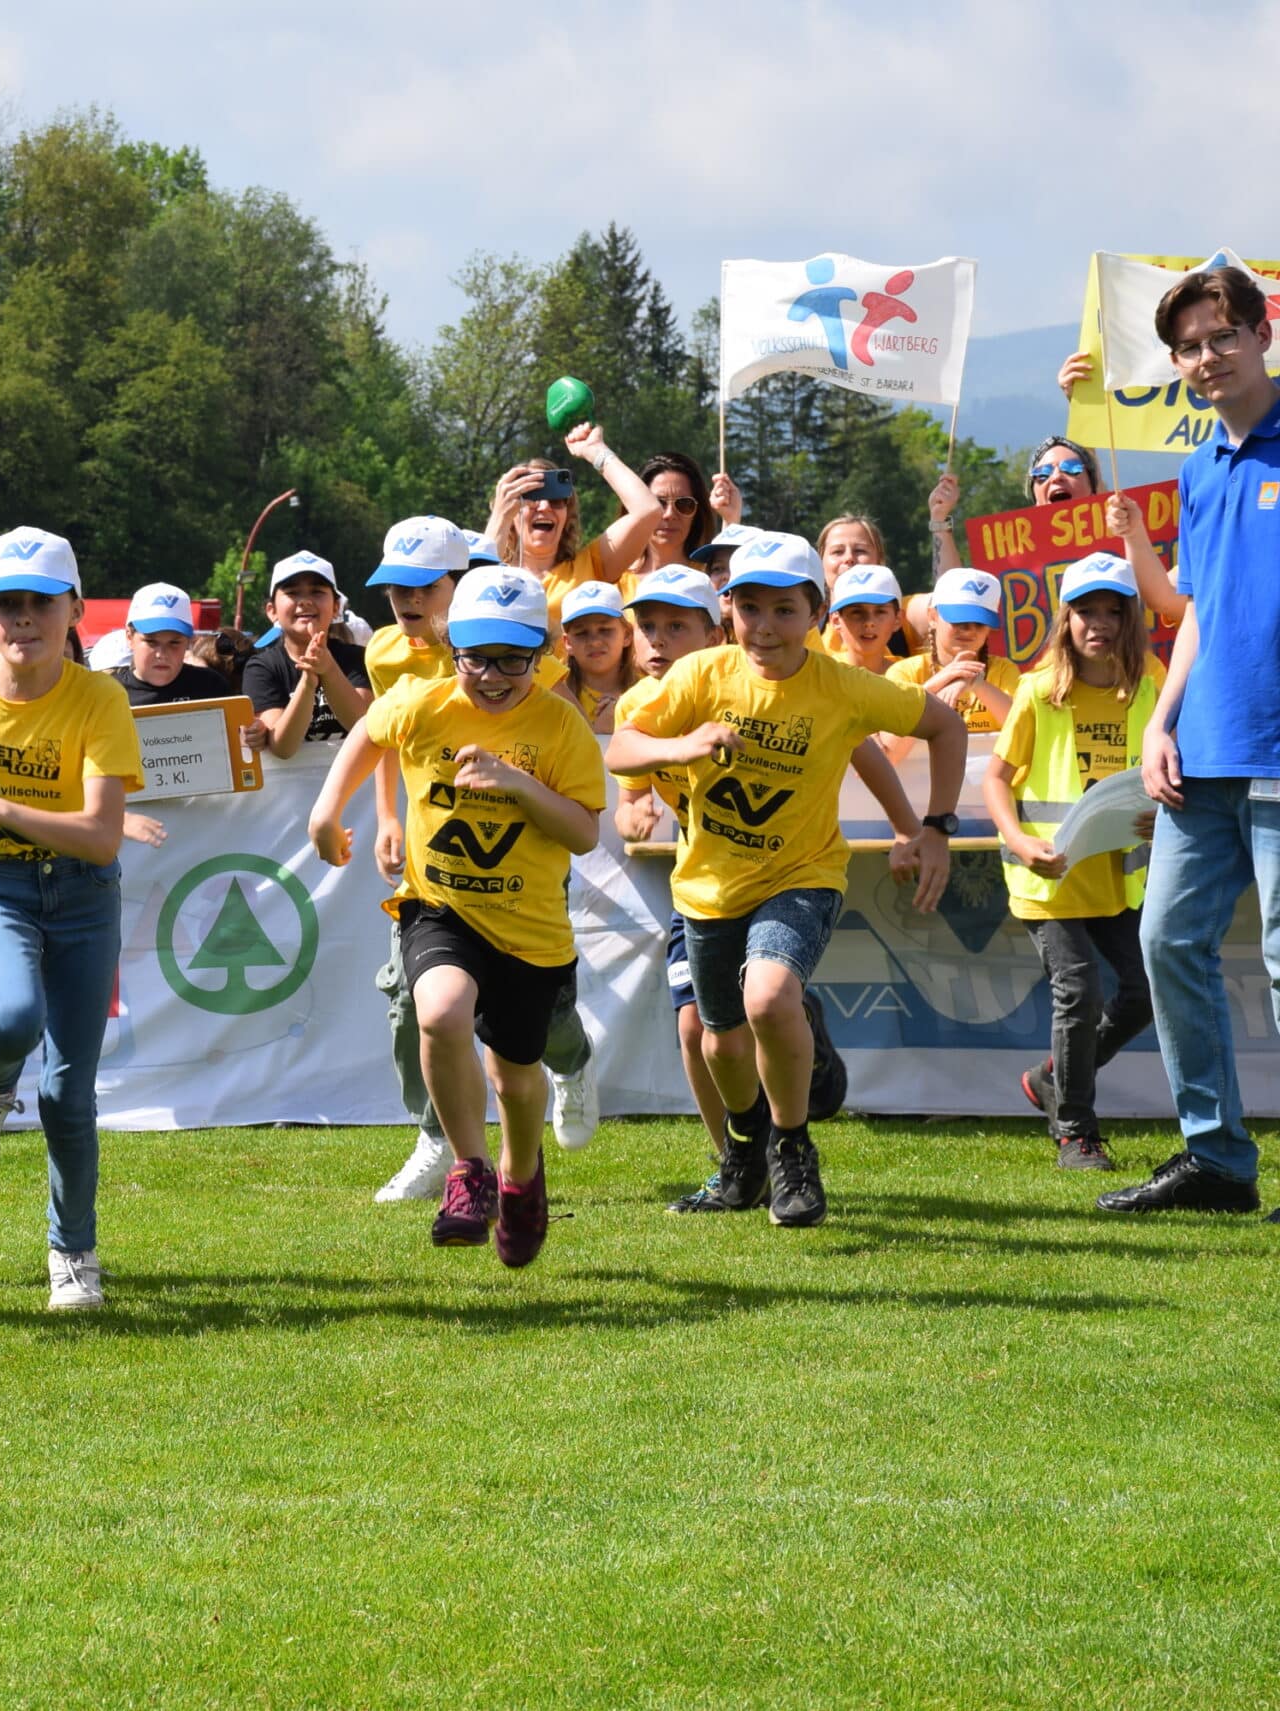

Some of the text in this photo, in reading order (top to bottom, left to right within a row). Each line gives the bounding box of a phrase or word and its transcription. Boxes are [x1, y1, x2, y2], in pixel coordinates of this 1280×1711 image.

[874, 335, 939, 355] WARTBERG
[982, 517, 1036, 561] IHR
[724, 711, 779, 734] SAFETY
[1076, 723, 1121, 733] SAFETY
[143, 734, 193, 747] Volksschule
[759, 735, 807, 755] tour
[8, 761, 59, 779] tour
[736, 752, 803, 775] Zivilschutz
[155, 774, 169, 787] 3.
[709, 822, 764, 848] SPAR
[439, 872, 502, 891] SPAR
